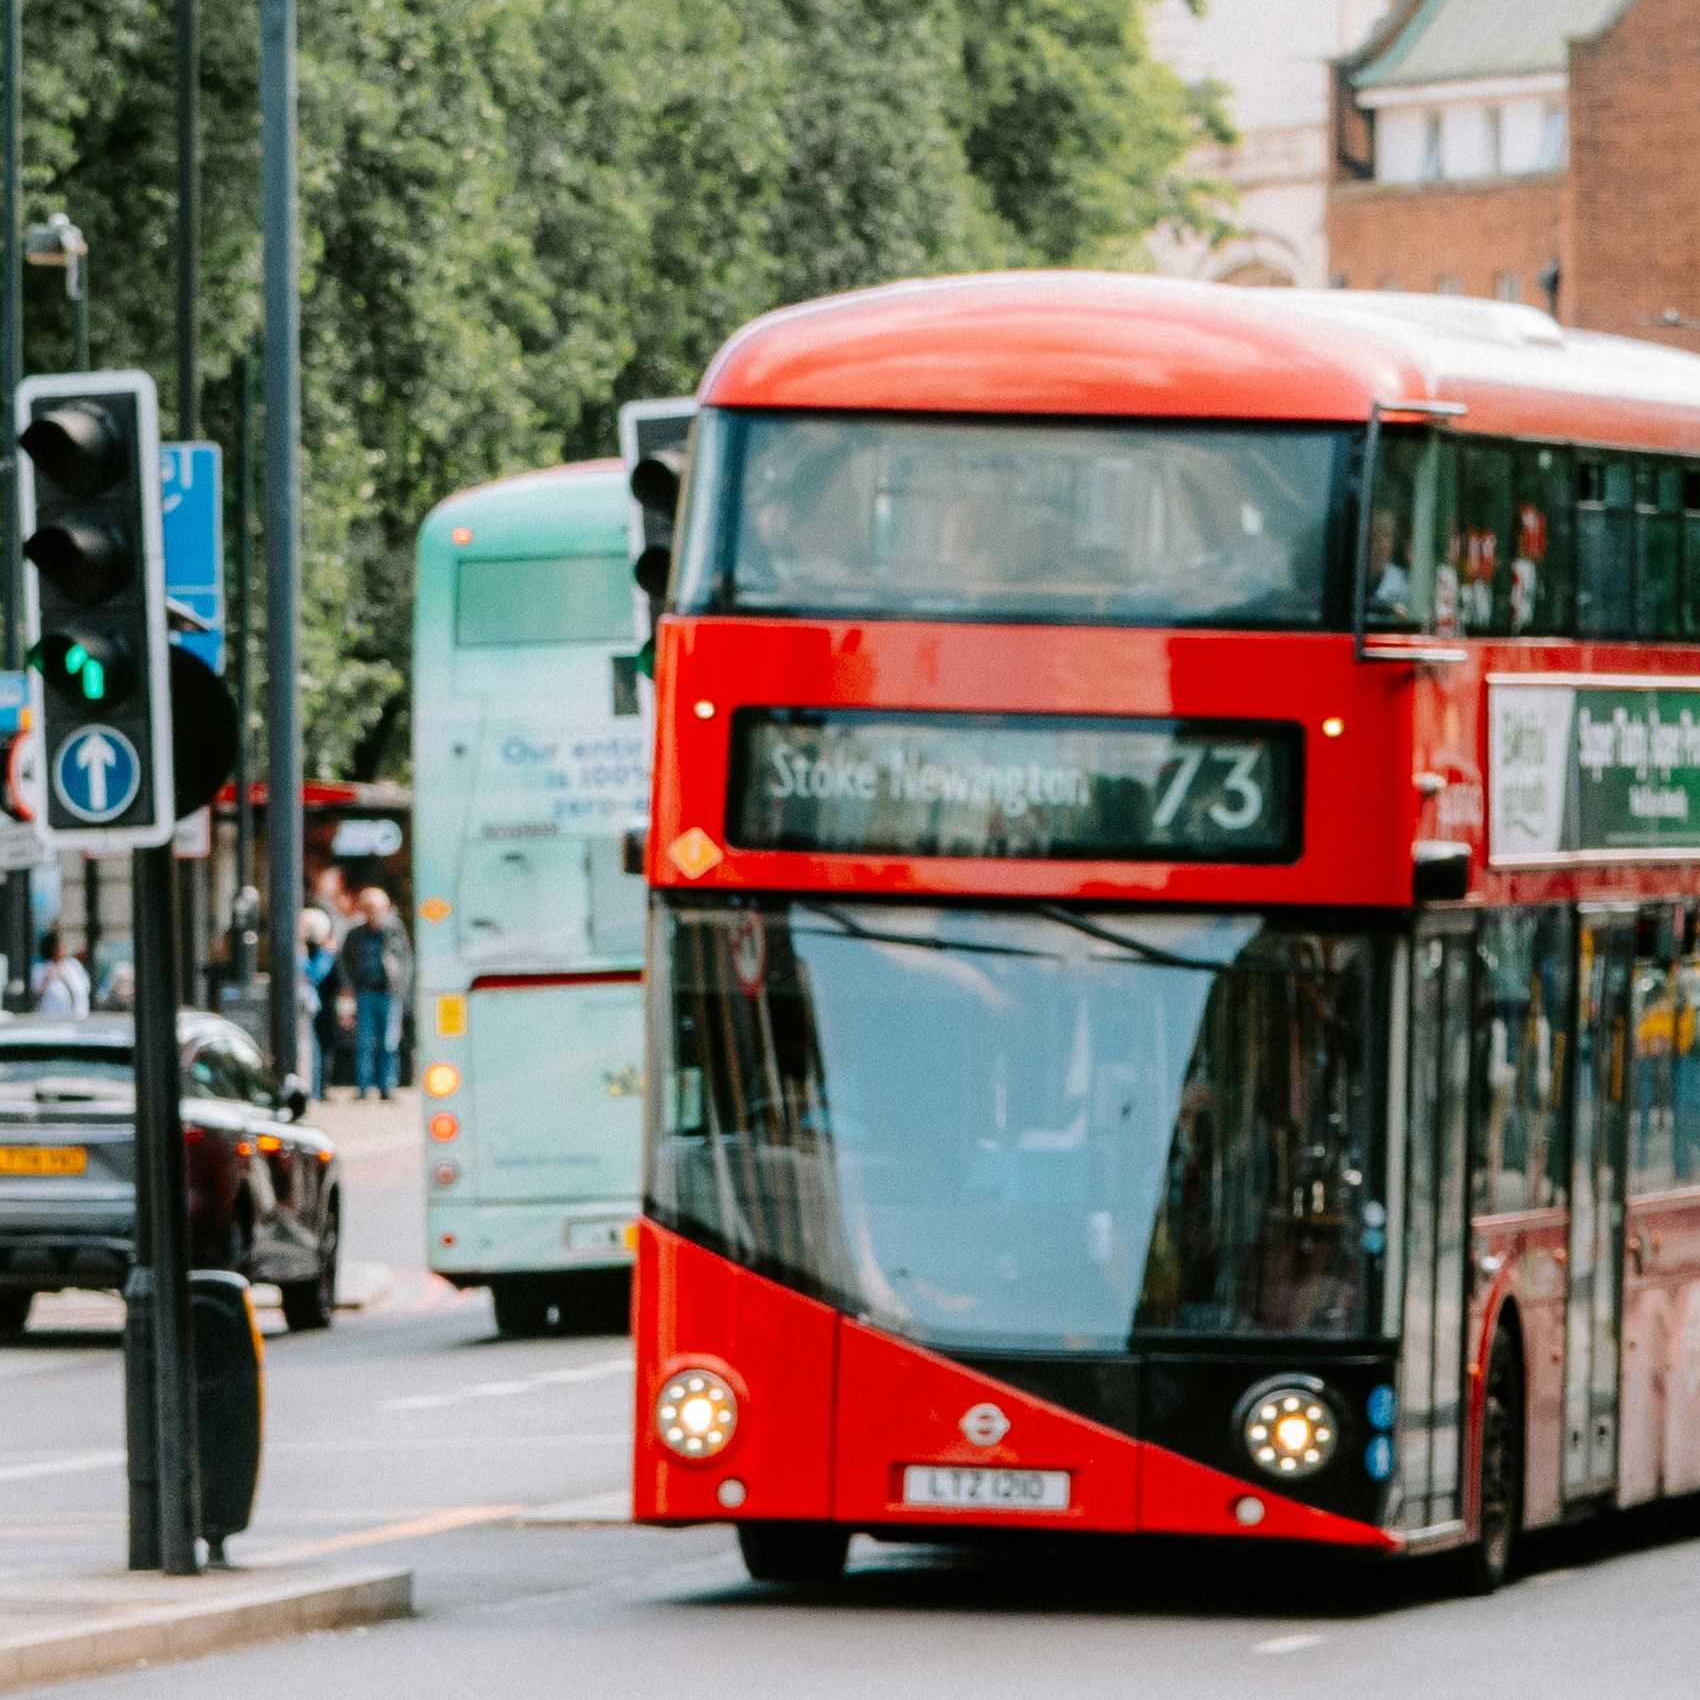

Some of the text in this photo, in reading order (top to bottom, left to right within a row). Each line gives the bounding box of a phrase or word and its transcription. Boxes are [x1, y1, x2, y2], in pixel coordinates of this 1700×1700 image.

[770, 744, 1263, 830] Stoke Newington 73
